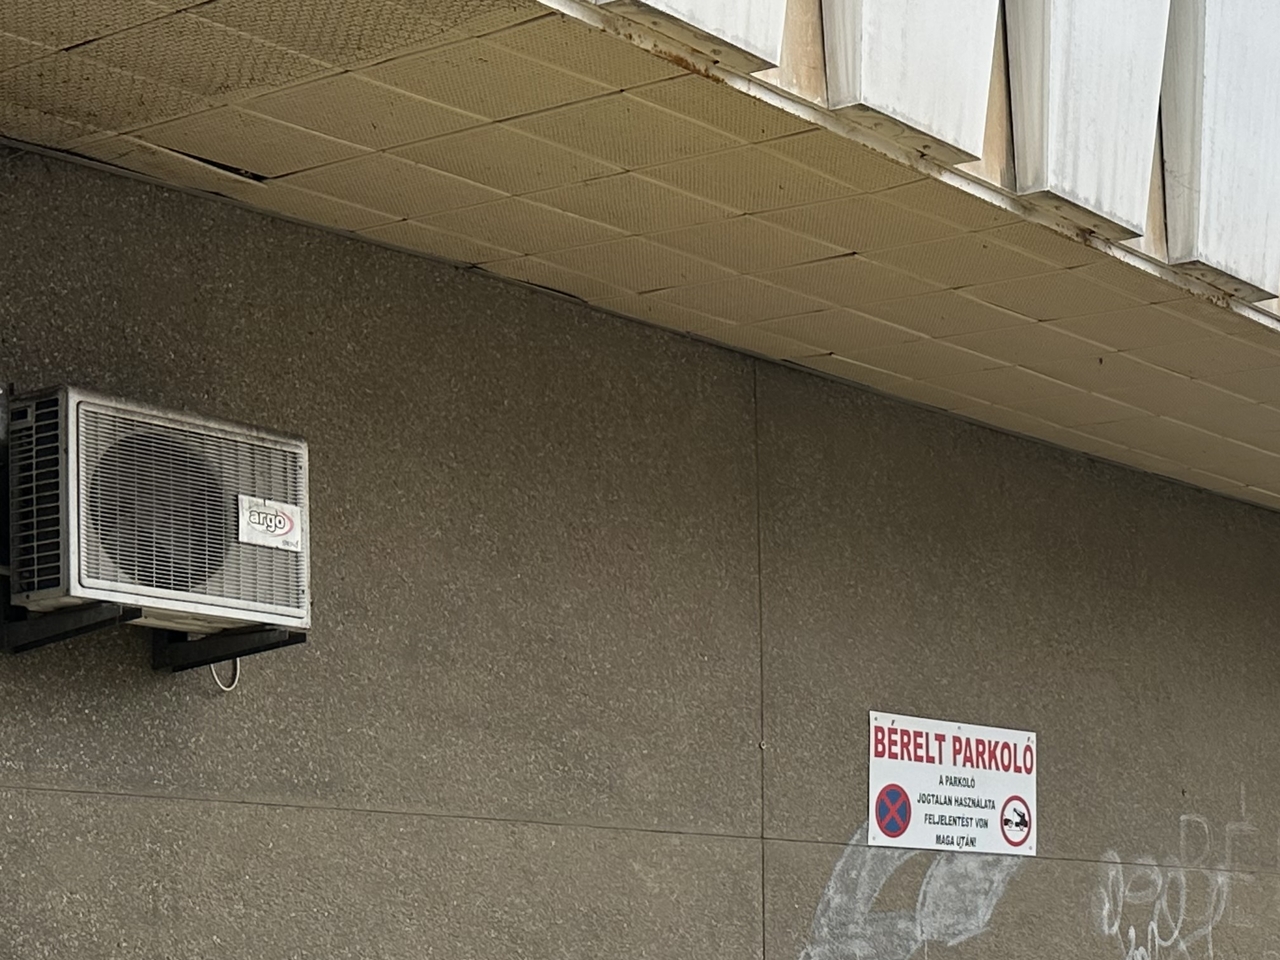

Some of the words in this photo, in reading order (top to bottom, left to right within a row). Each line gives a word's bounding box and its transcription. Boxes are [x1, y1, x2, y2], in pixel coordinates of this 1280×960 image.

[249, 510, 285, 533] argo
[873, 720, 947, 766] BÉRELT
[952, 736, 1034, 776] PARKOLÓ
[938, 774, 944, 786] A
[945, 775, 976, 789] PARKOLÓ
[916, 792, 953, 806] JOGTALAN
[953, 795, 996, 810] HASZNÁLATA
[923, 813, 974, 829] FELJELENTÉST
[975, 817, 989, 829] VON
[935, 834, 955, 847] MAGA
